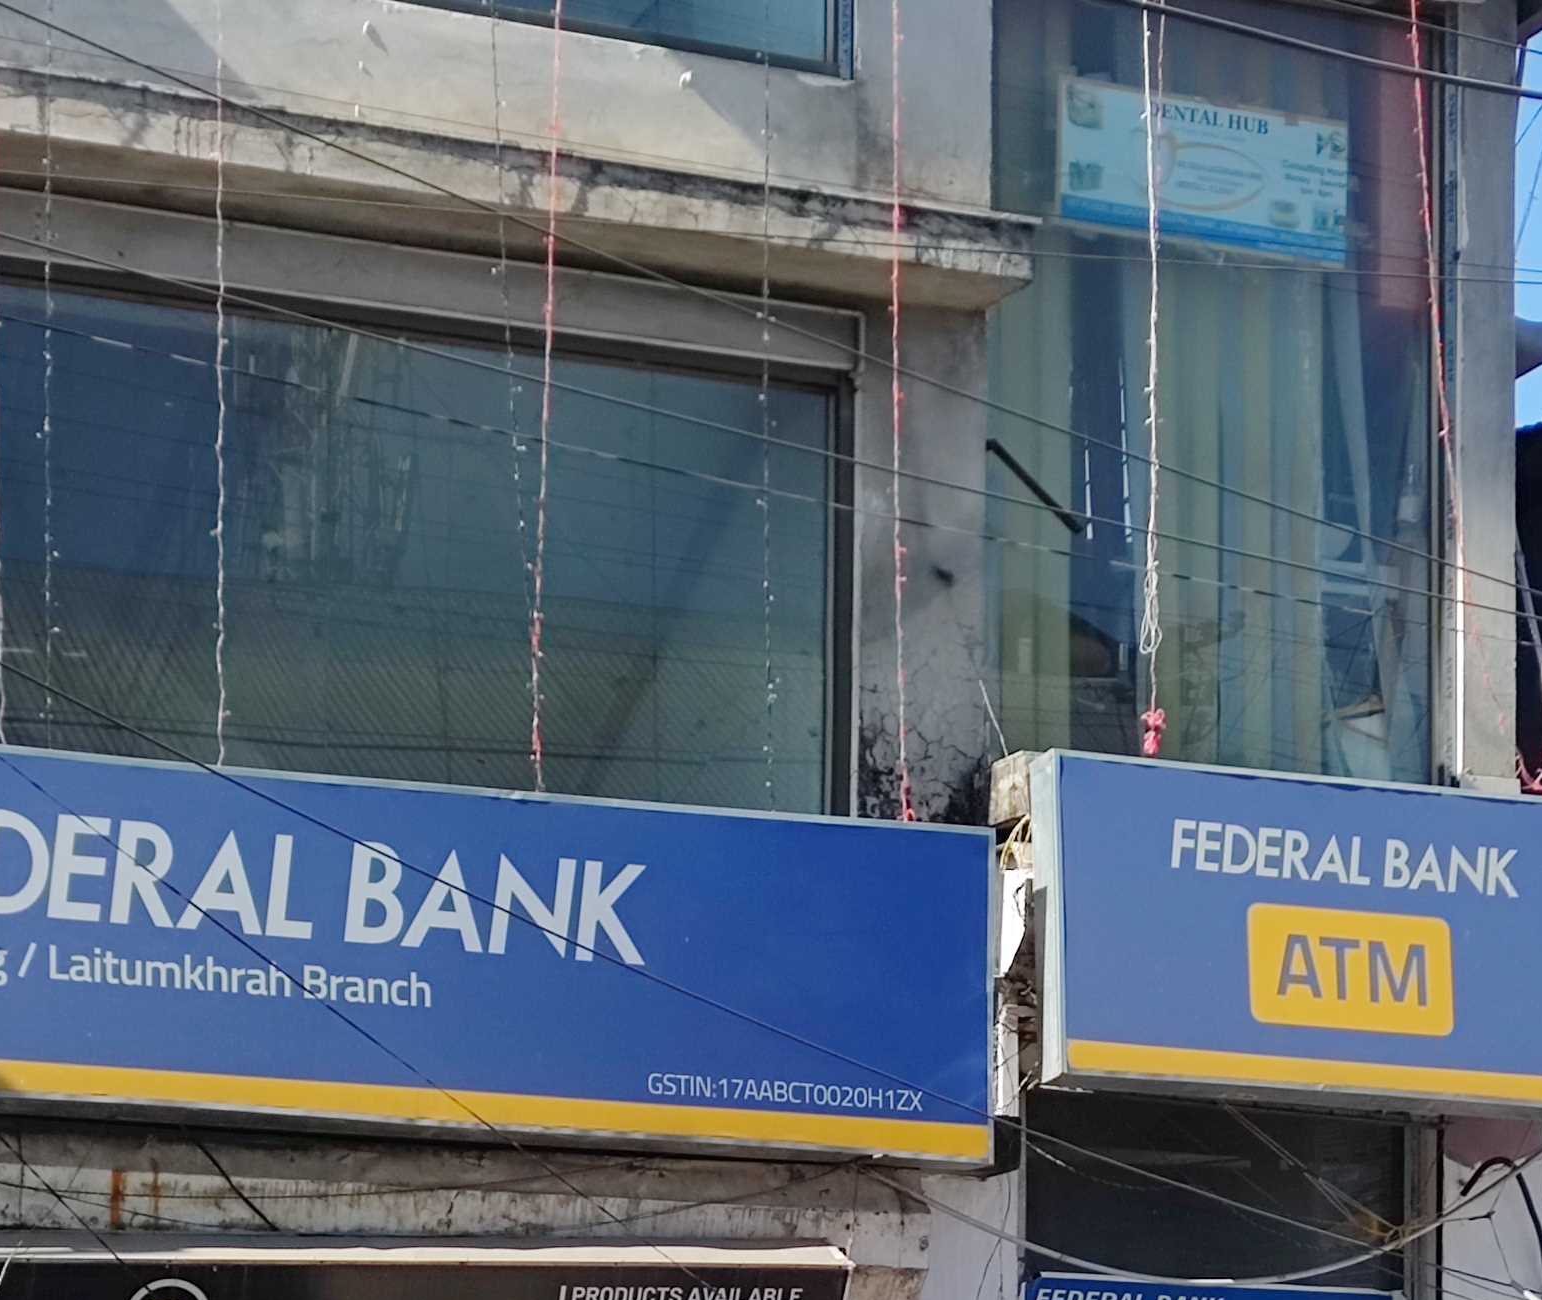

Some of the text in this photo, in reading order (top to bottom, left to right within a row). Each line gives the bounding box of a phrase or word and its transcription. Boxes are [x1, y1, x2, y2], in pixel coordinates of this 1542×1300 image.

[1229, 114, 1268, 135] HUB
[1170, 818, 1519, 899] FEDERAL BANK
[344, 841, 647, 966] BANK
[49, 944, 291, 999] Laitumkhrah
[304, 965, 432, 1011] Branch
[1276, 932, 1428, 1007] ATM
